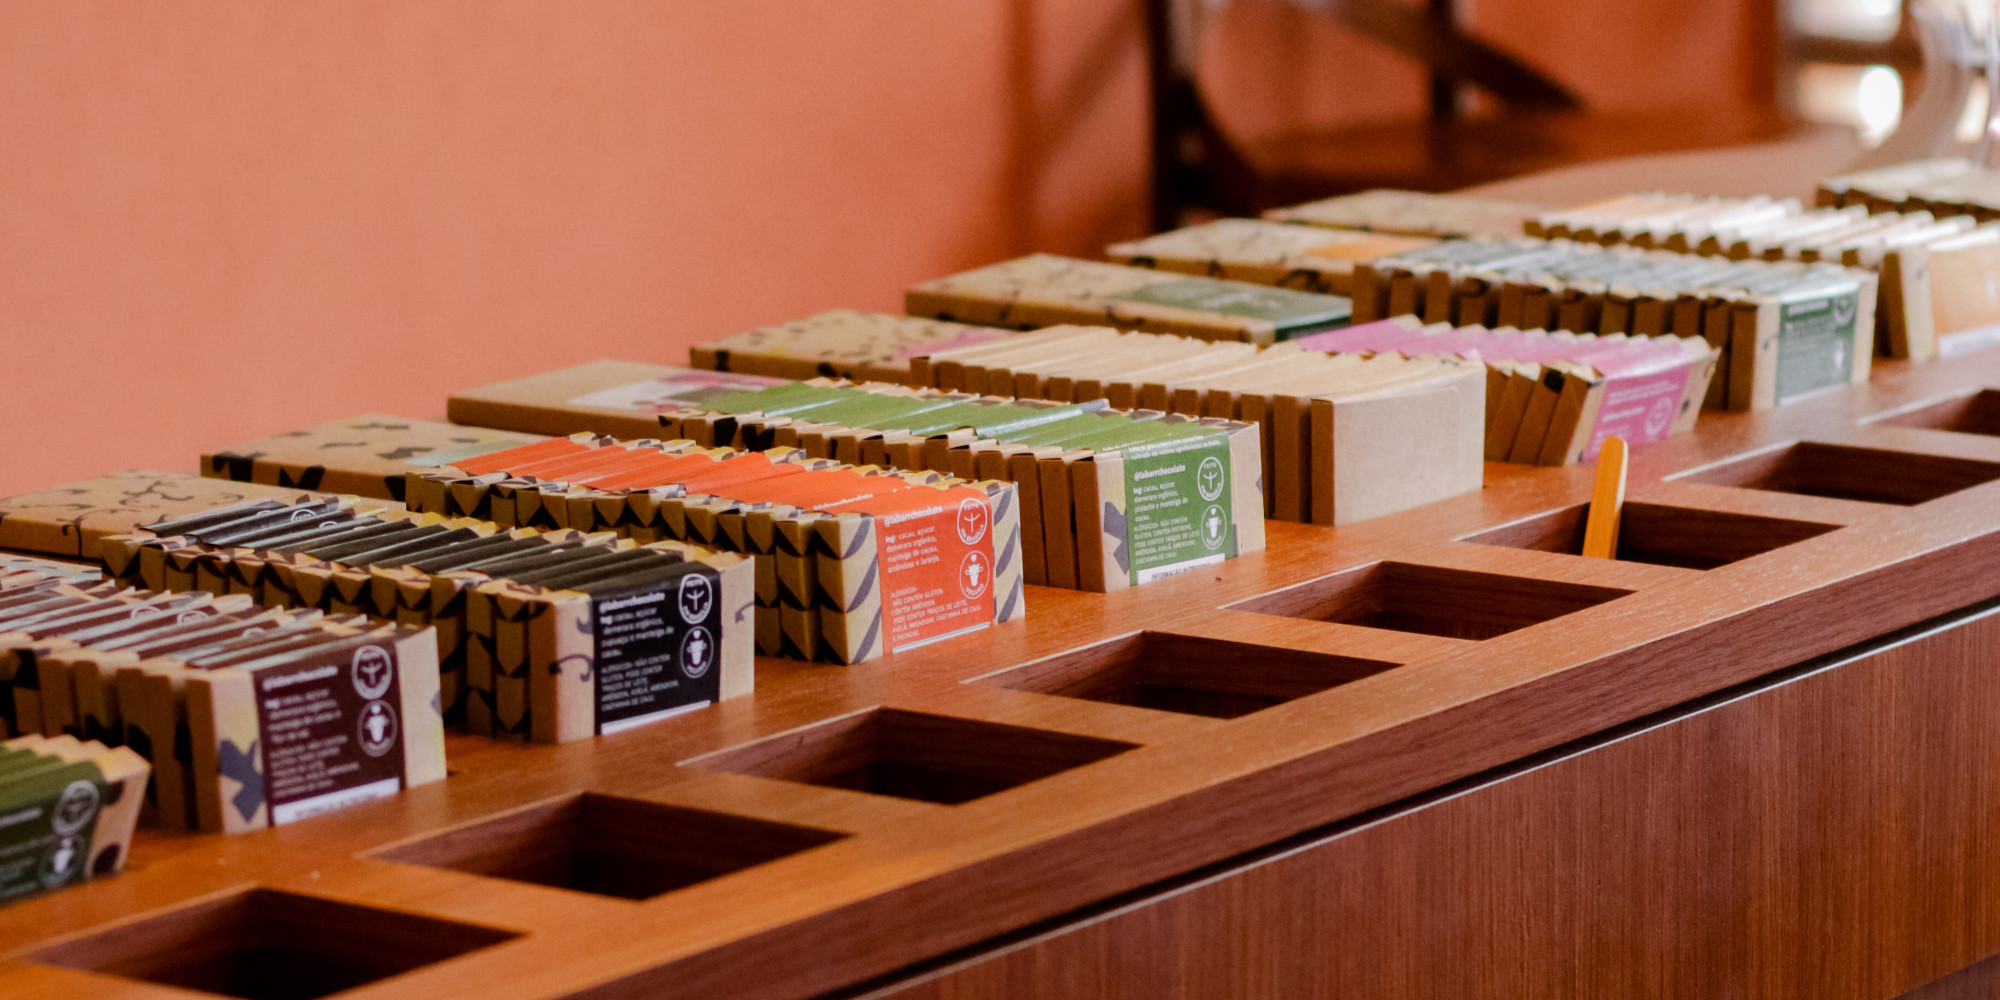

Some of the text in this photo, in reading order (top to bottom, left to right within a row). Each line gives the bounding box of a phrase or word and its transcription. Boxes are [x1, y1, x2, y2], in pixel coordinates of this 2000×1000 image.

[1135, 465, 1185, 481] @labarrchocolate
[884, 506, 943, 527] @labarrchocolate
[917, 526, 935, 536] açúcar
[886, 541, 911, 553] demerara
[887, 552, 911, 564] manteiga
[966, 583, 984, 596] VEGANO
[893, 597, 902, 606] NÃO
